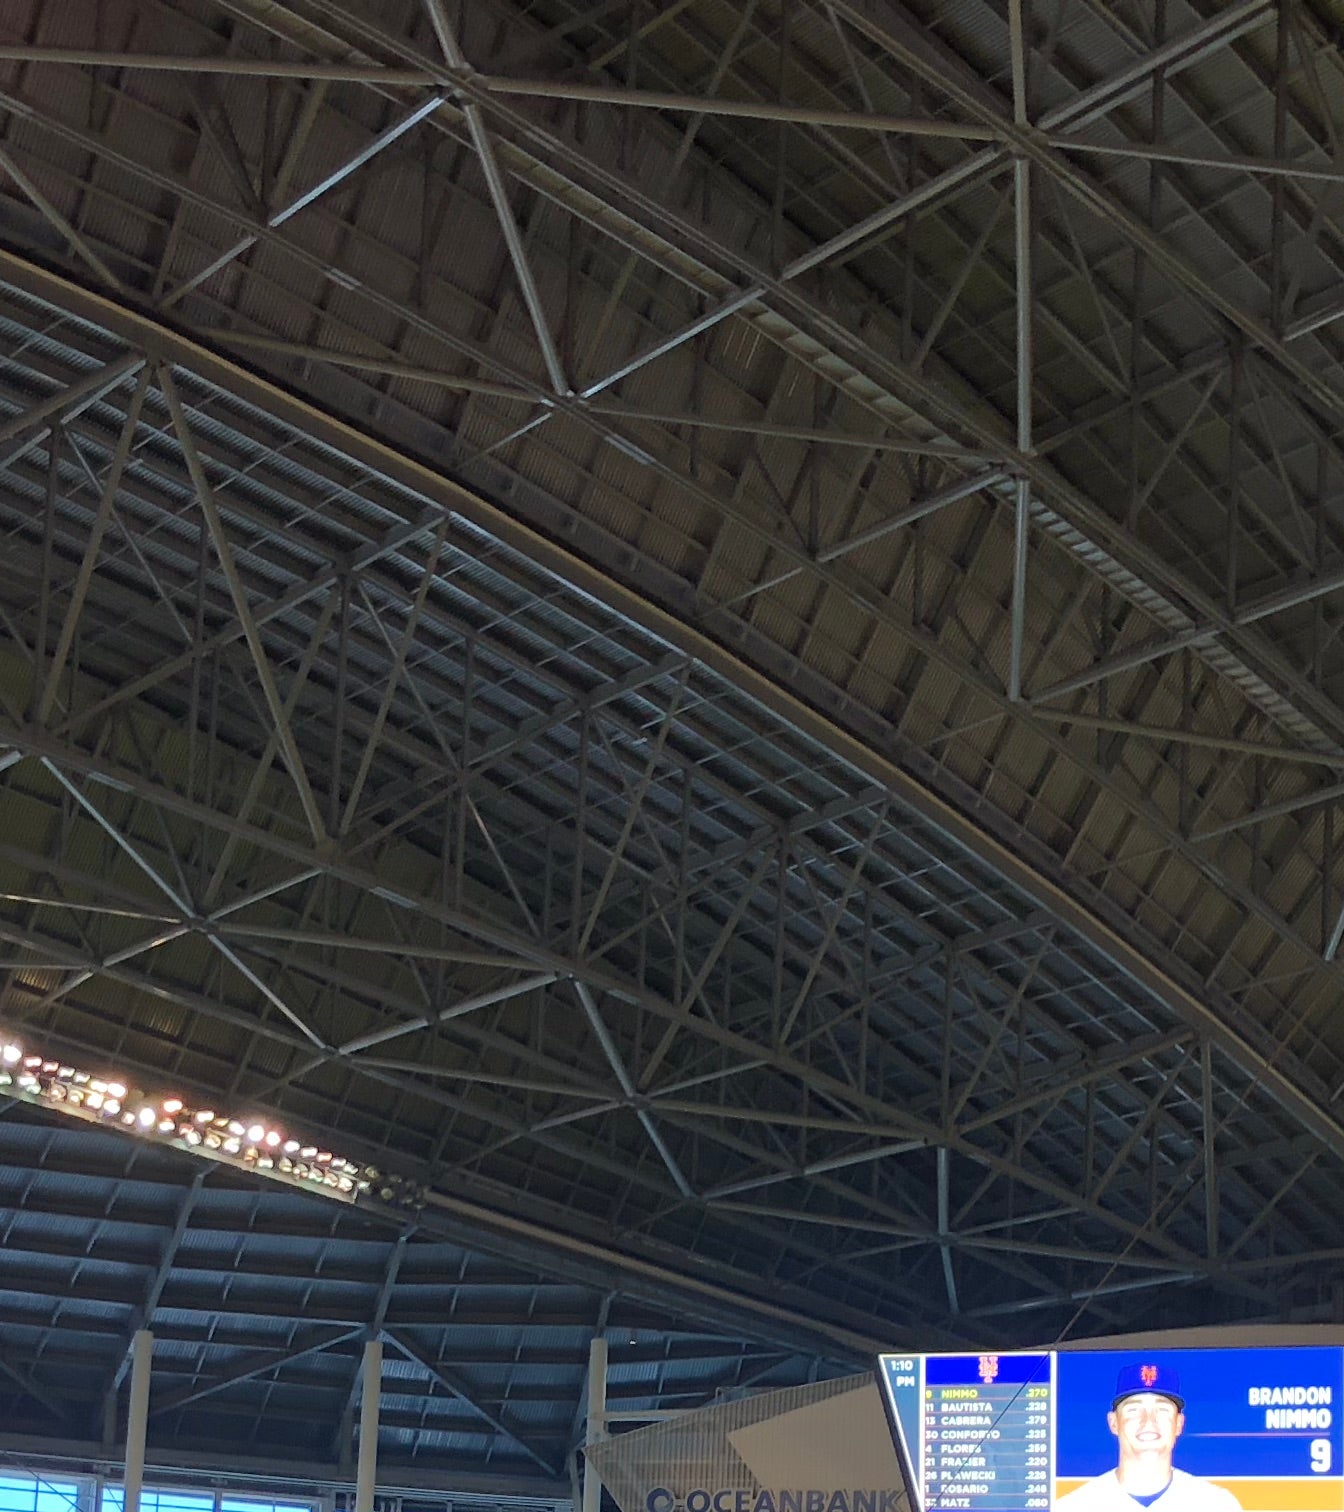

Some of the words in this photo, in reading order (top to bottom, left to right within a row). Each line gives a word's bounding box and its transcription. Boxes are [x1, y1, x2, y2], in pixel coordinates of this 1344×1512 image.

[891, 1360, 913, 1371] 1:10
[896, 1376, 915, 1387] PM
[941, 1389, 978, 1399] NIMMO
[1249, 1386, 1331, 1406] BRANDON
[941, 1402, 993, 1412] BAUTISTA
[941, 1416, 991, 1425] CABRERA
[1266, 1409, 1331, 1429] NIMMO
[1311, 1439, 1331, 1472] 9
[941, 1499, 970, 1507] MATZ
